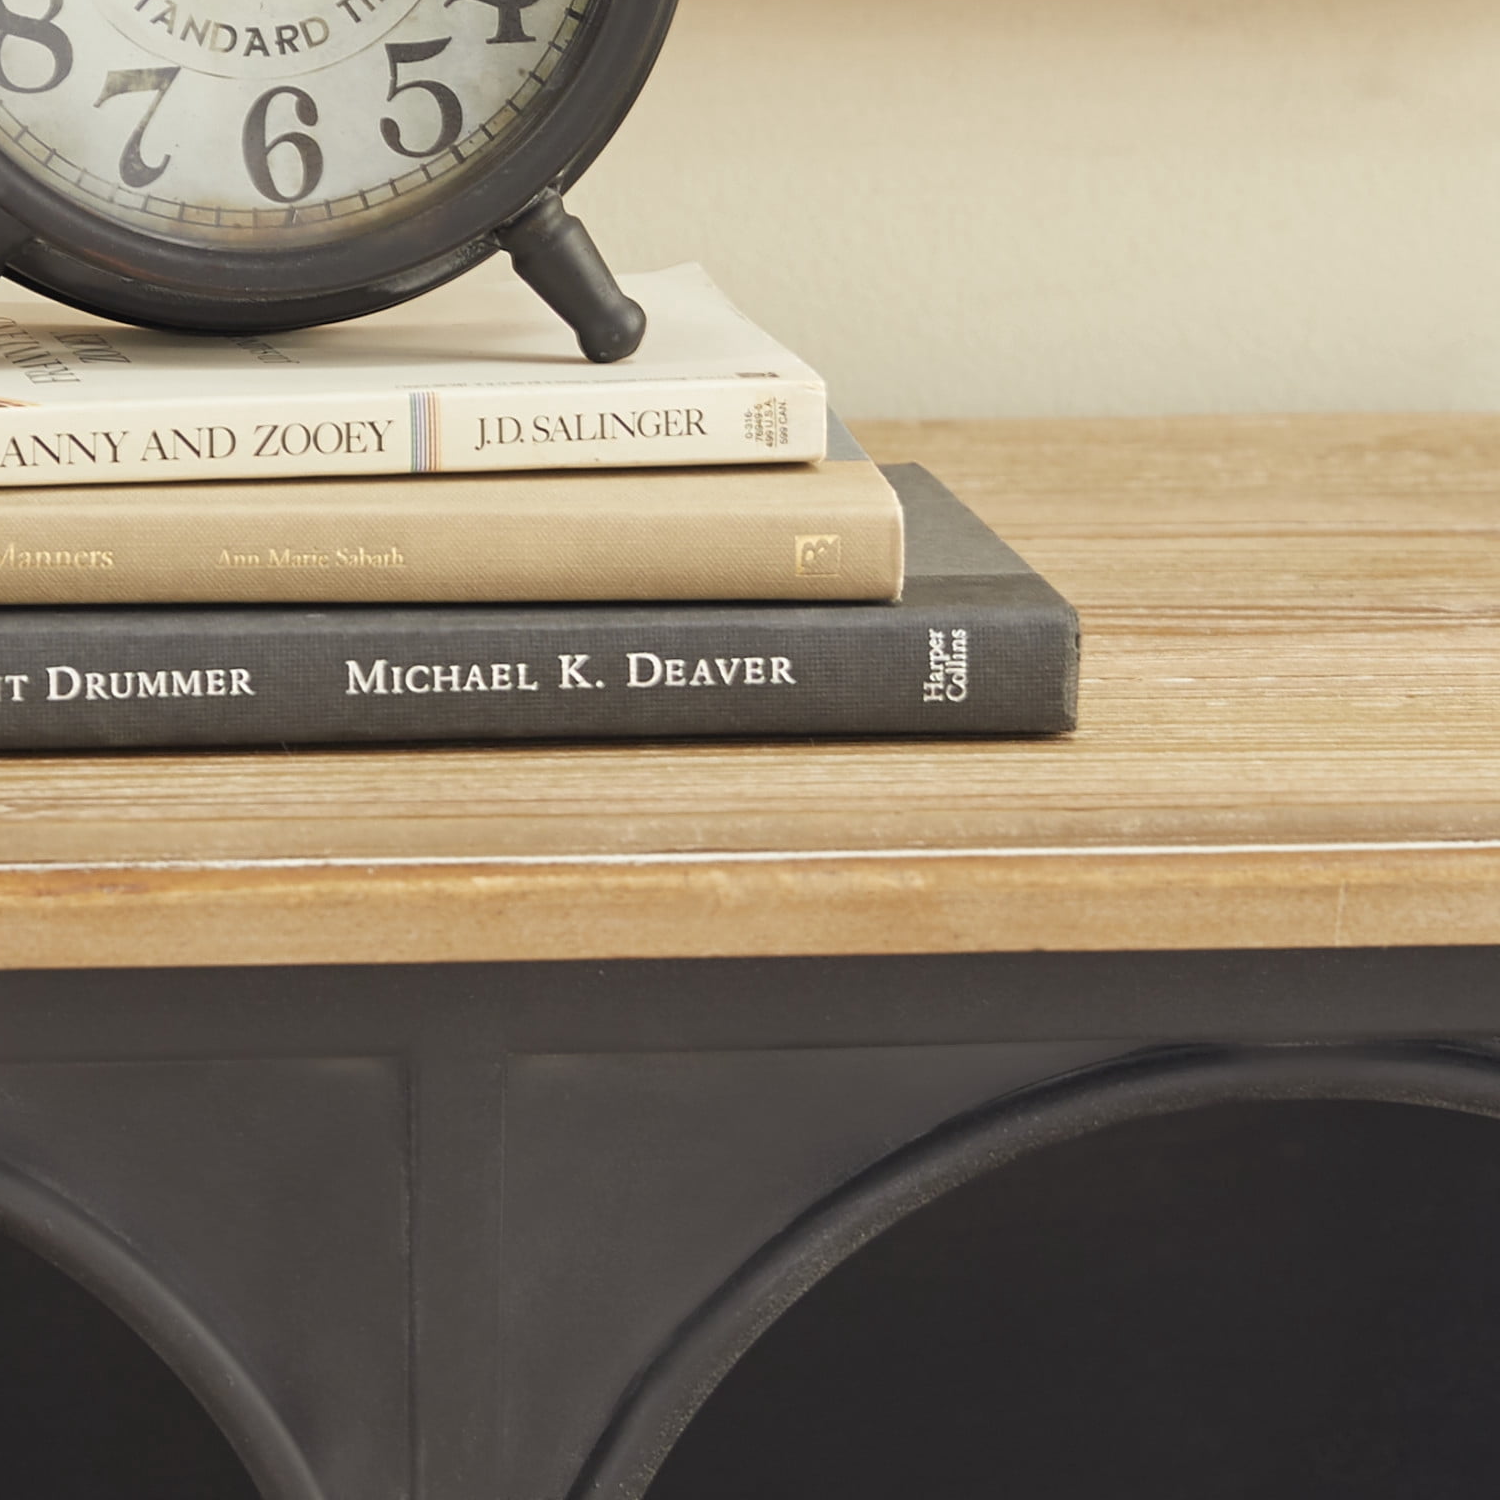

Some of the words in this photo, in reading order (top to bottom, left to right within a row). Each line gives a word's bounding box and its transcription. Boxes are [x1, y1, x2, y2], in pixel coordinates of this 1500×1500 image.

[379, 37, 463, 157] 5
[93, 66, 181, 188] 7
[242, 86, 323, 203] 6
[140, 426, 237, 462] AND
[254, 419, 393, 458] ZOOEY
[474, 415, 523, 451] J.D.
[531, 408, 708, 445] SALINGER
[216, 548, 260, 568] Ann
[268, 547, 330, 568] Marie
[336, 545, 405, 568] Sabath
[45, 664, 256, 702] DRUMMER
[345, 655, 538, 696] MICHAEL
[557, 652, 605, 690] K.
[627, 650, 797, 689] DEAVER
[923, 628, 950, 702] Harper
[944, 629, 968, 702] Collins
